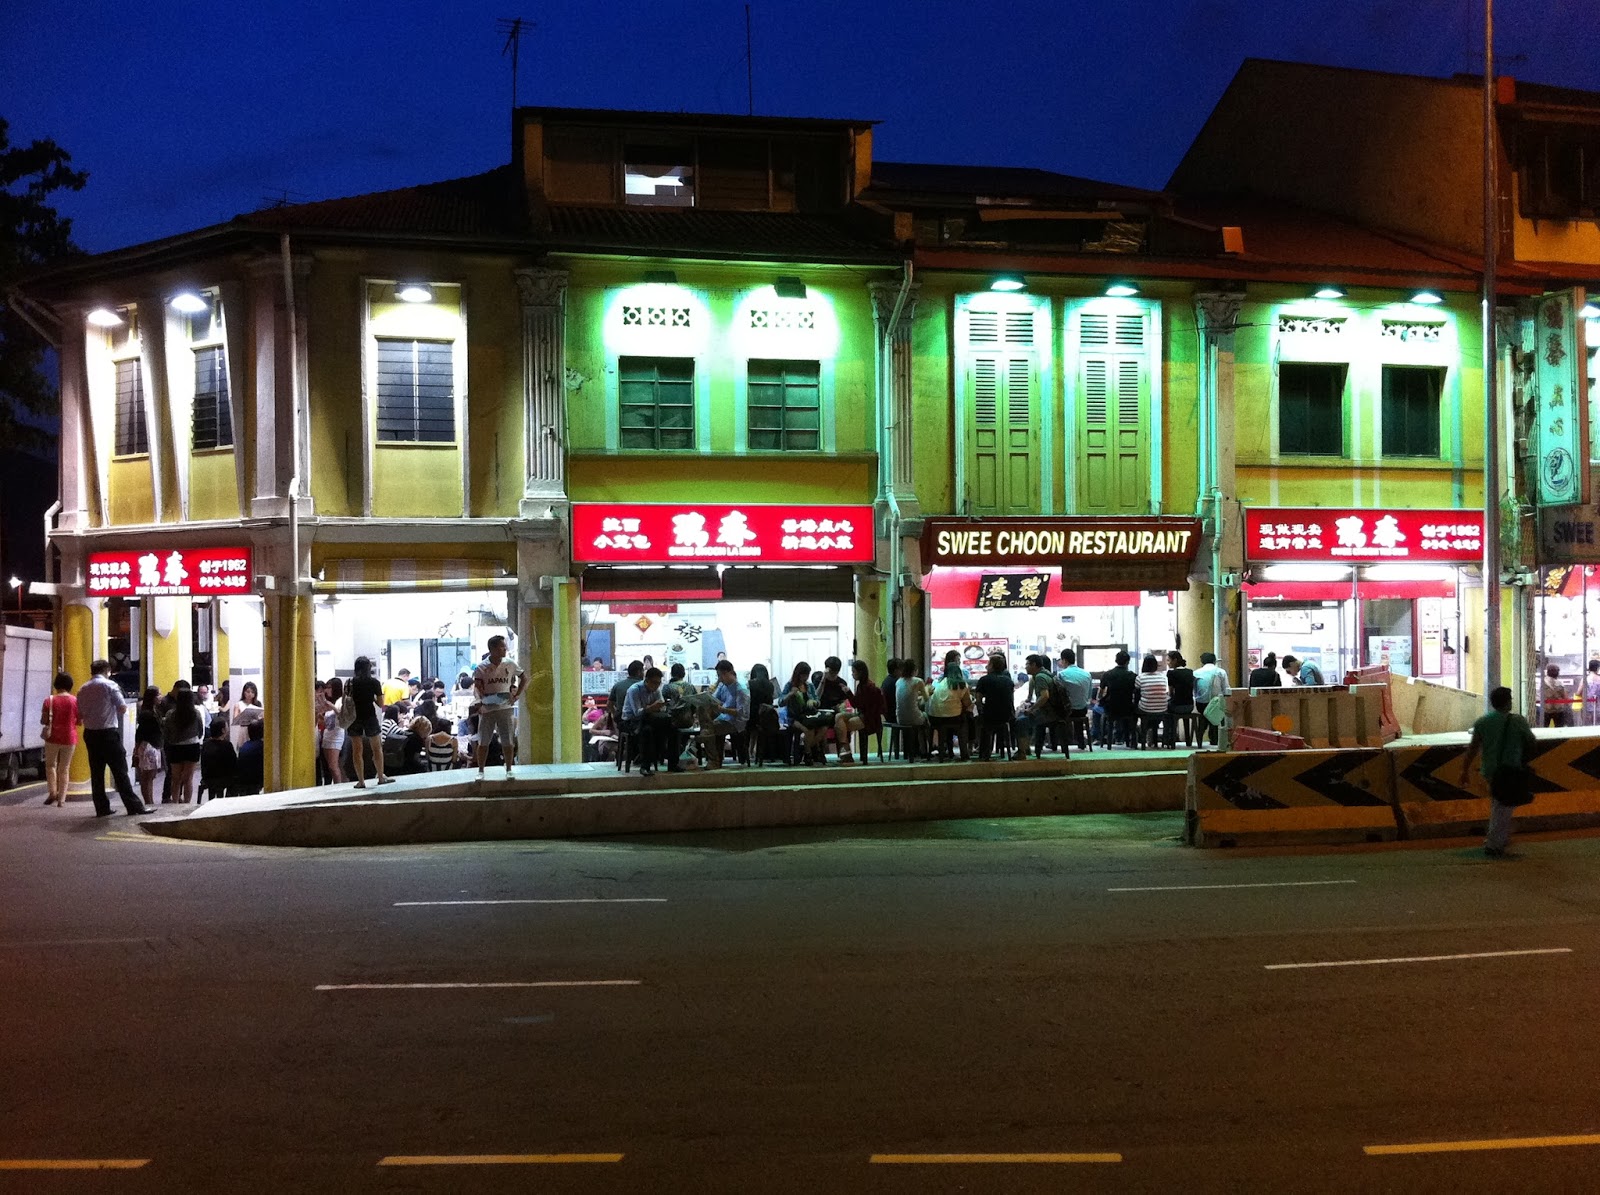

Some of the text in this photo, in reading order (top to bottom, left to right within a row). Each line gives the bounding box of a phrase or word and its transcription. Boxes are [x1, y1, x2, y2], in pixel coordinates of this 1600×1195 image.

[937, 530, 1192, 555] SWEE CHOON RESTAURANT
[1553, 521, 1595, 544] SWEE
